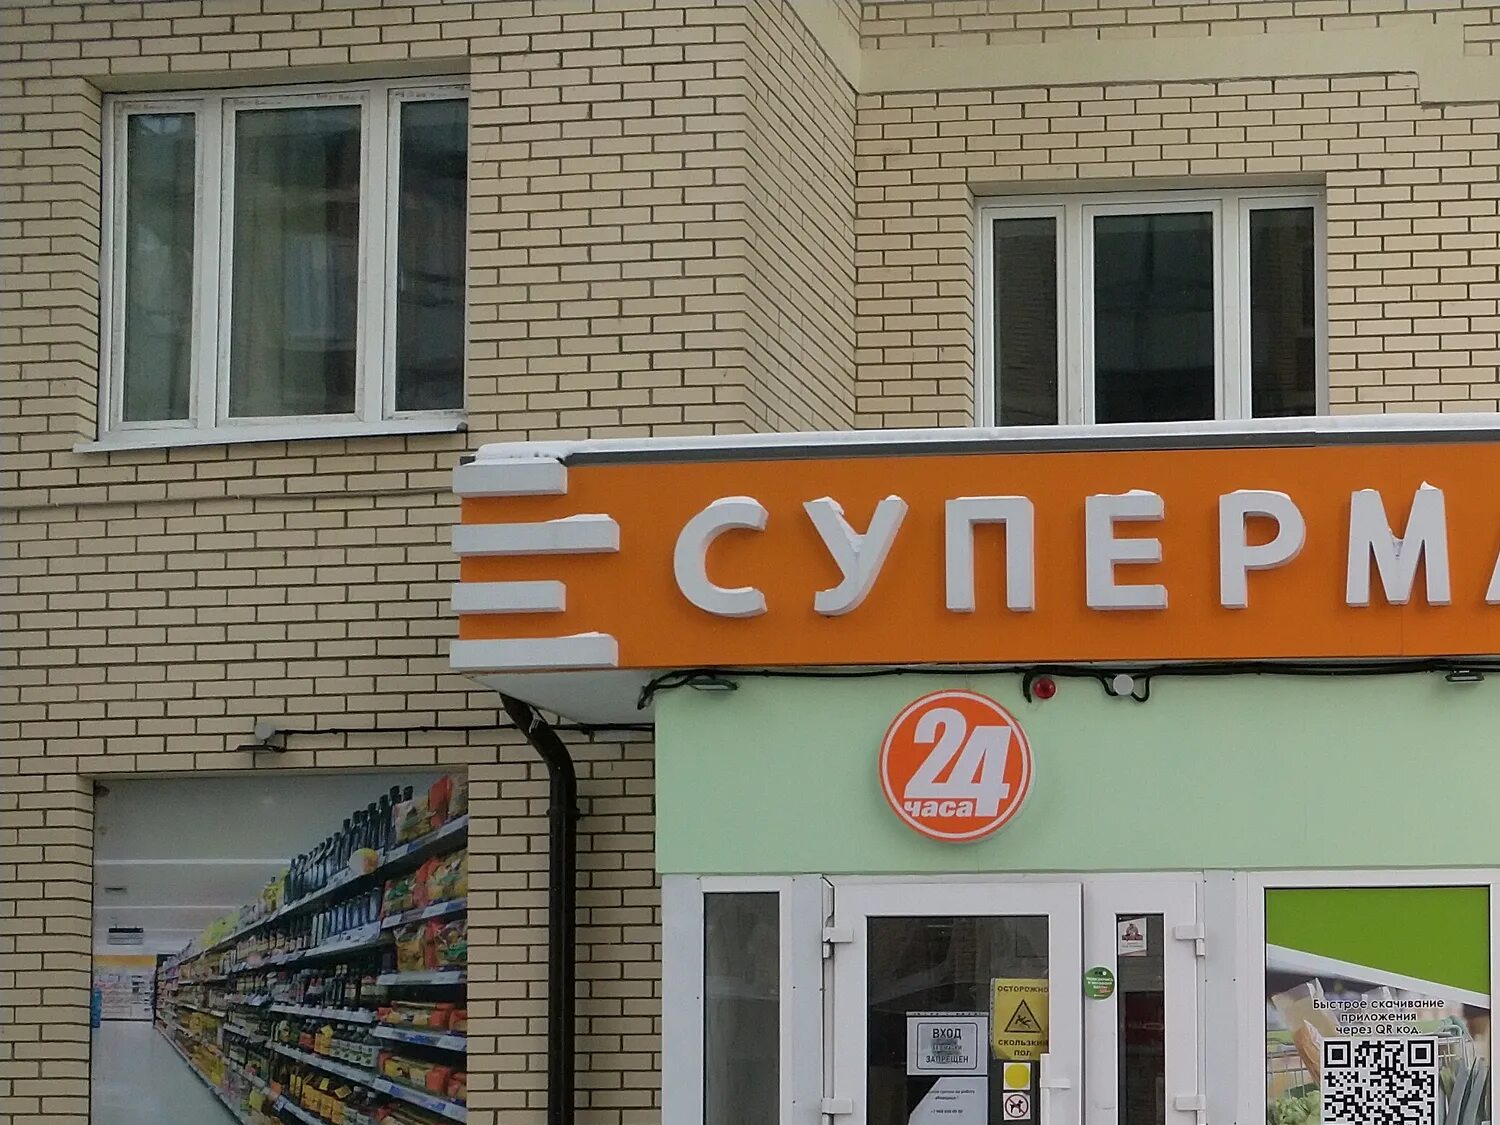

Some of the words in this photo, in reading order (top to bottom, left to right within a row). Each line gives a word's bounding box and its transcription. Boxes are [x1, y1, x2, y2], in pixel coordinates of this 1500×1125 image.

[904, 708, 1012, 817] 24
[903, 800, 974, 818] часа
[997, 985, 1049, 993] ОСТОРОЖНО
[1313, 998, 1367, 1010] Быстрое
[1371, 999, 1445, 1008] скачивание
[1341, 1013, 1417, 1023] приложения
[932, 1028, 962, 1040] ВХОД
[1335, 1025, 1372, 1036] через
[1375, 1025, 1393, 1035] QR
[1396, 1025, 1422, 1035] код.
[925, 1055, 969, 1064] ЗАПРЕЩЕН
